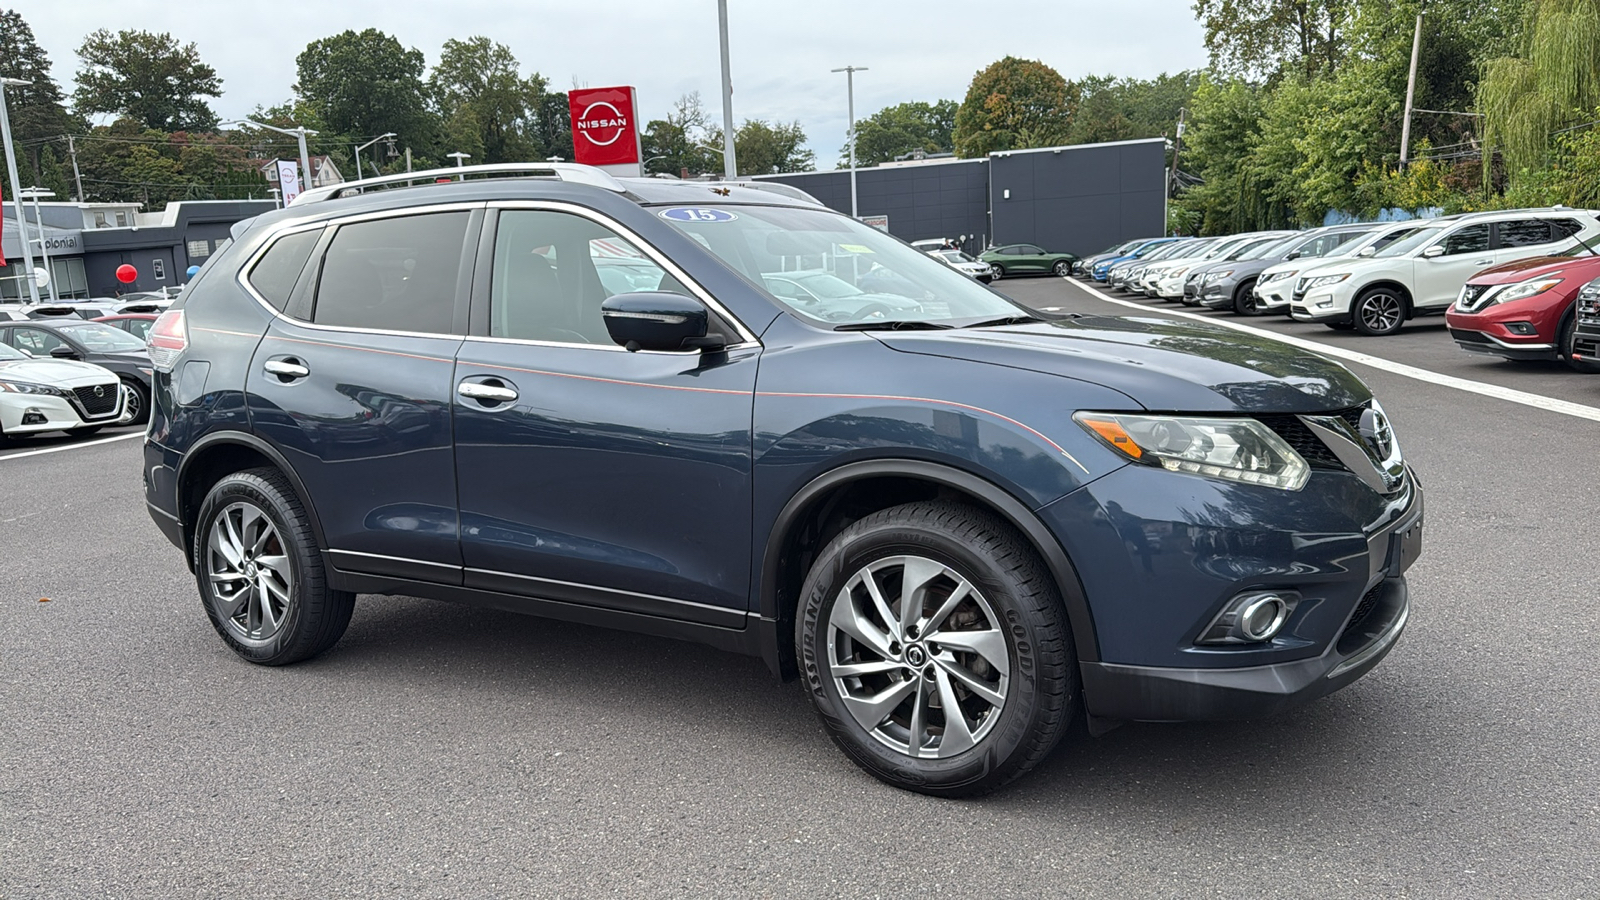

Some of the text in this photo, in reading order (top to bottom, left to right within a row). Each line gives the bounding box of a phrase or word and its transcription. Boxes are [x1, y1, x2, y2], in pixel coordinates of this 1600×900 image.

[577, 118, 627, 129] NISSAN
[684, 209, 717, 221] 15
[803, 582, 828, 700] ASSURANCE
[1004, 608, 1035, 747] GOODYEAR
